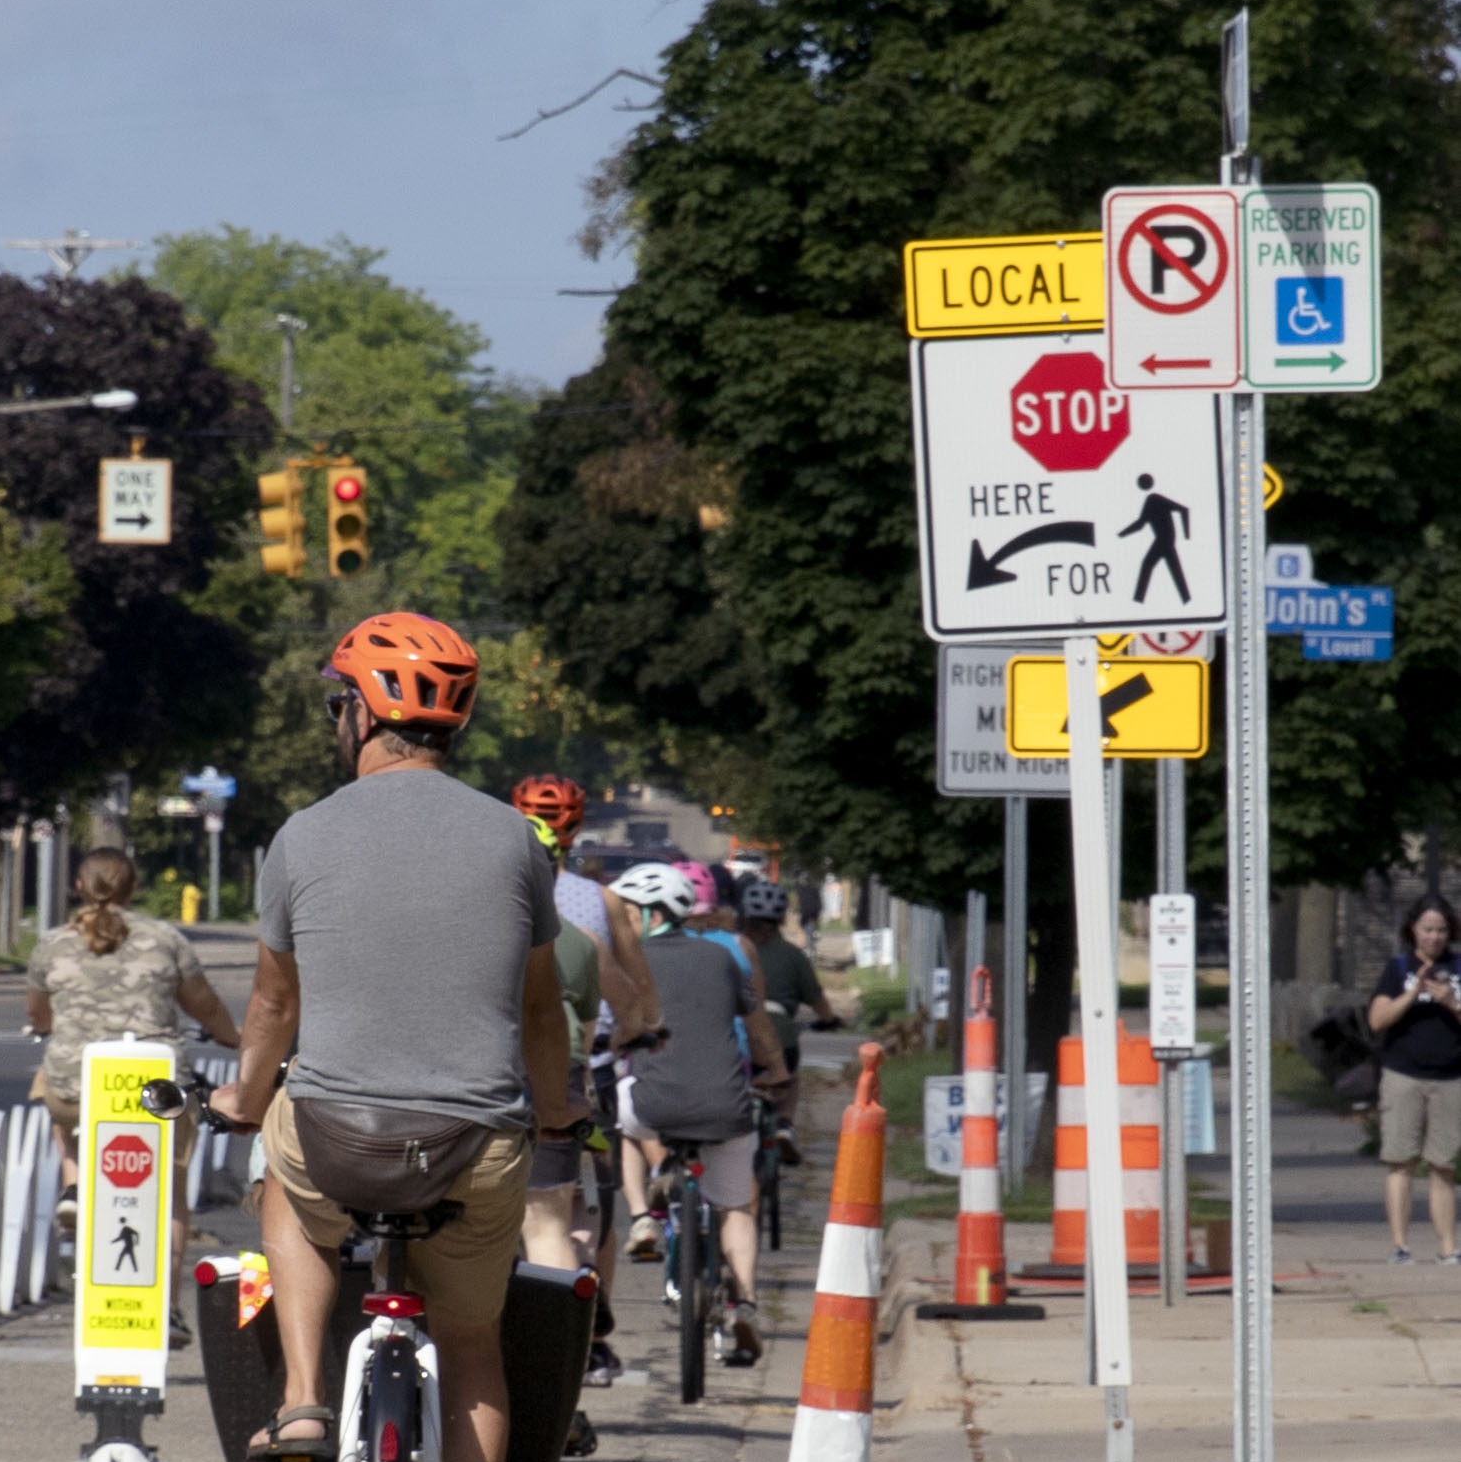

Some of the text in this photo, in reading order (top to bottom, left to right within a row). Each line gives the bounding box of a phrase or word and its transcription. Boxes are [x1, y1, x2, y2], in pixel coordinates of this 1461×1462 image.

[1251, 207, 1366, 232] RESERVED
[1257, 241, 1361, 267] PARKING
[941, 262, 1080, 309] LOCAL
[1015, 389, 1125, 436] STOP
[115, 469, 154, 488] ONE
[115, 490, 156, 509] WAY
[970, 482, 1055, 517] HERE
[1047, 562, 1112, 596] FOR
[1265, 590, 1368, 627] John's
[951, 664, 1007, 686] RIGH
[950, 751, 1070, 774] TURN RIGH
[104, 1073, 150, 1091] LOCA
[103, 1149, 152, 1174] STOP
[113, 1196, 140, 1209] FOR
[89, 1316, 157, 1330] CROSSWALK
